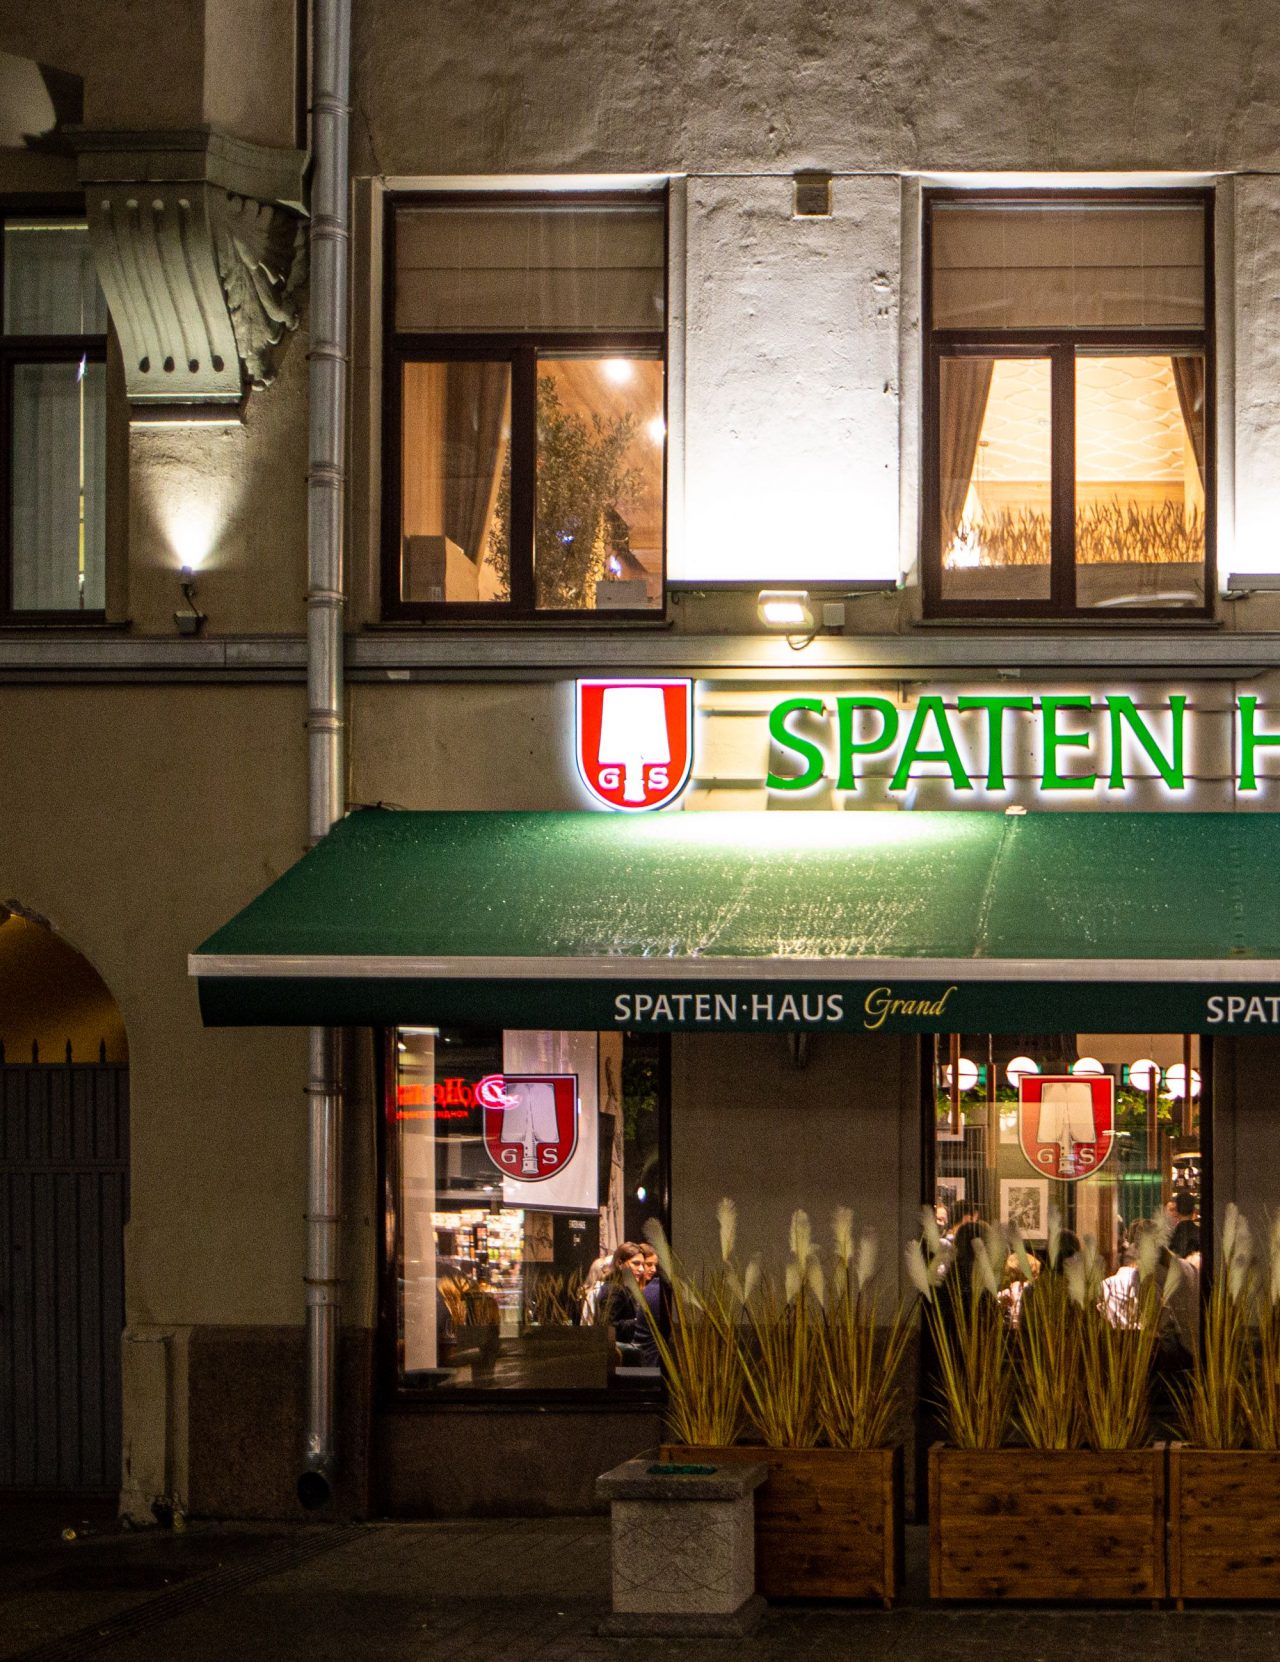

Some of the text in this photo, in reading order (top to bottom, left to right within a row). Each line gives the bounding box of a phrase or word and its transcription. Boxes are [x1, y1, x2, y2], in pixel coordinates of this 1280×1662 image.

[765, 695, 1187, 792] SPATEN
[598, 766, 669, 791] G S
[863, 985, 958, 1030] Grand
[500, 1148, 558, 1165] G S
[1037, 1148, 1095, 1164] G S
